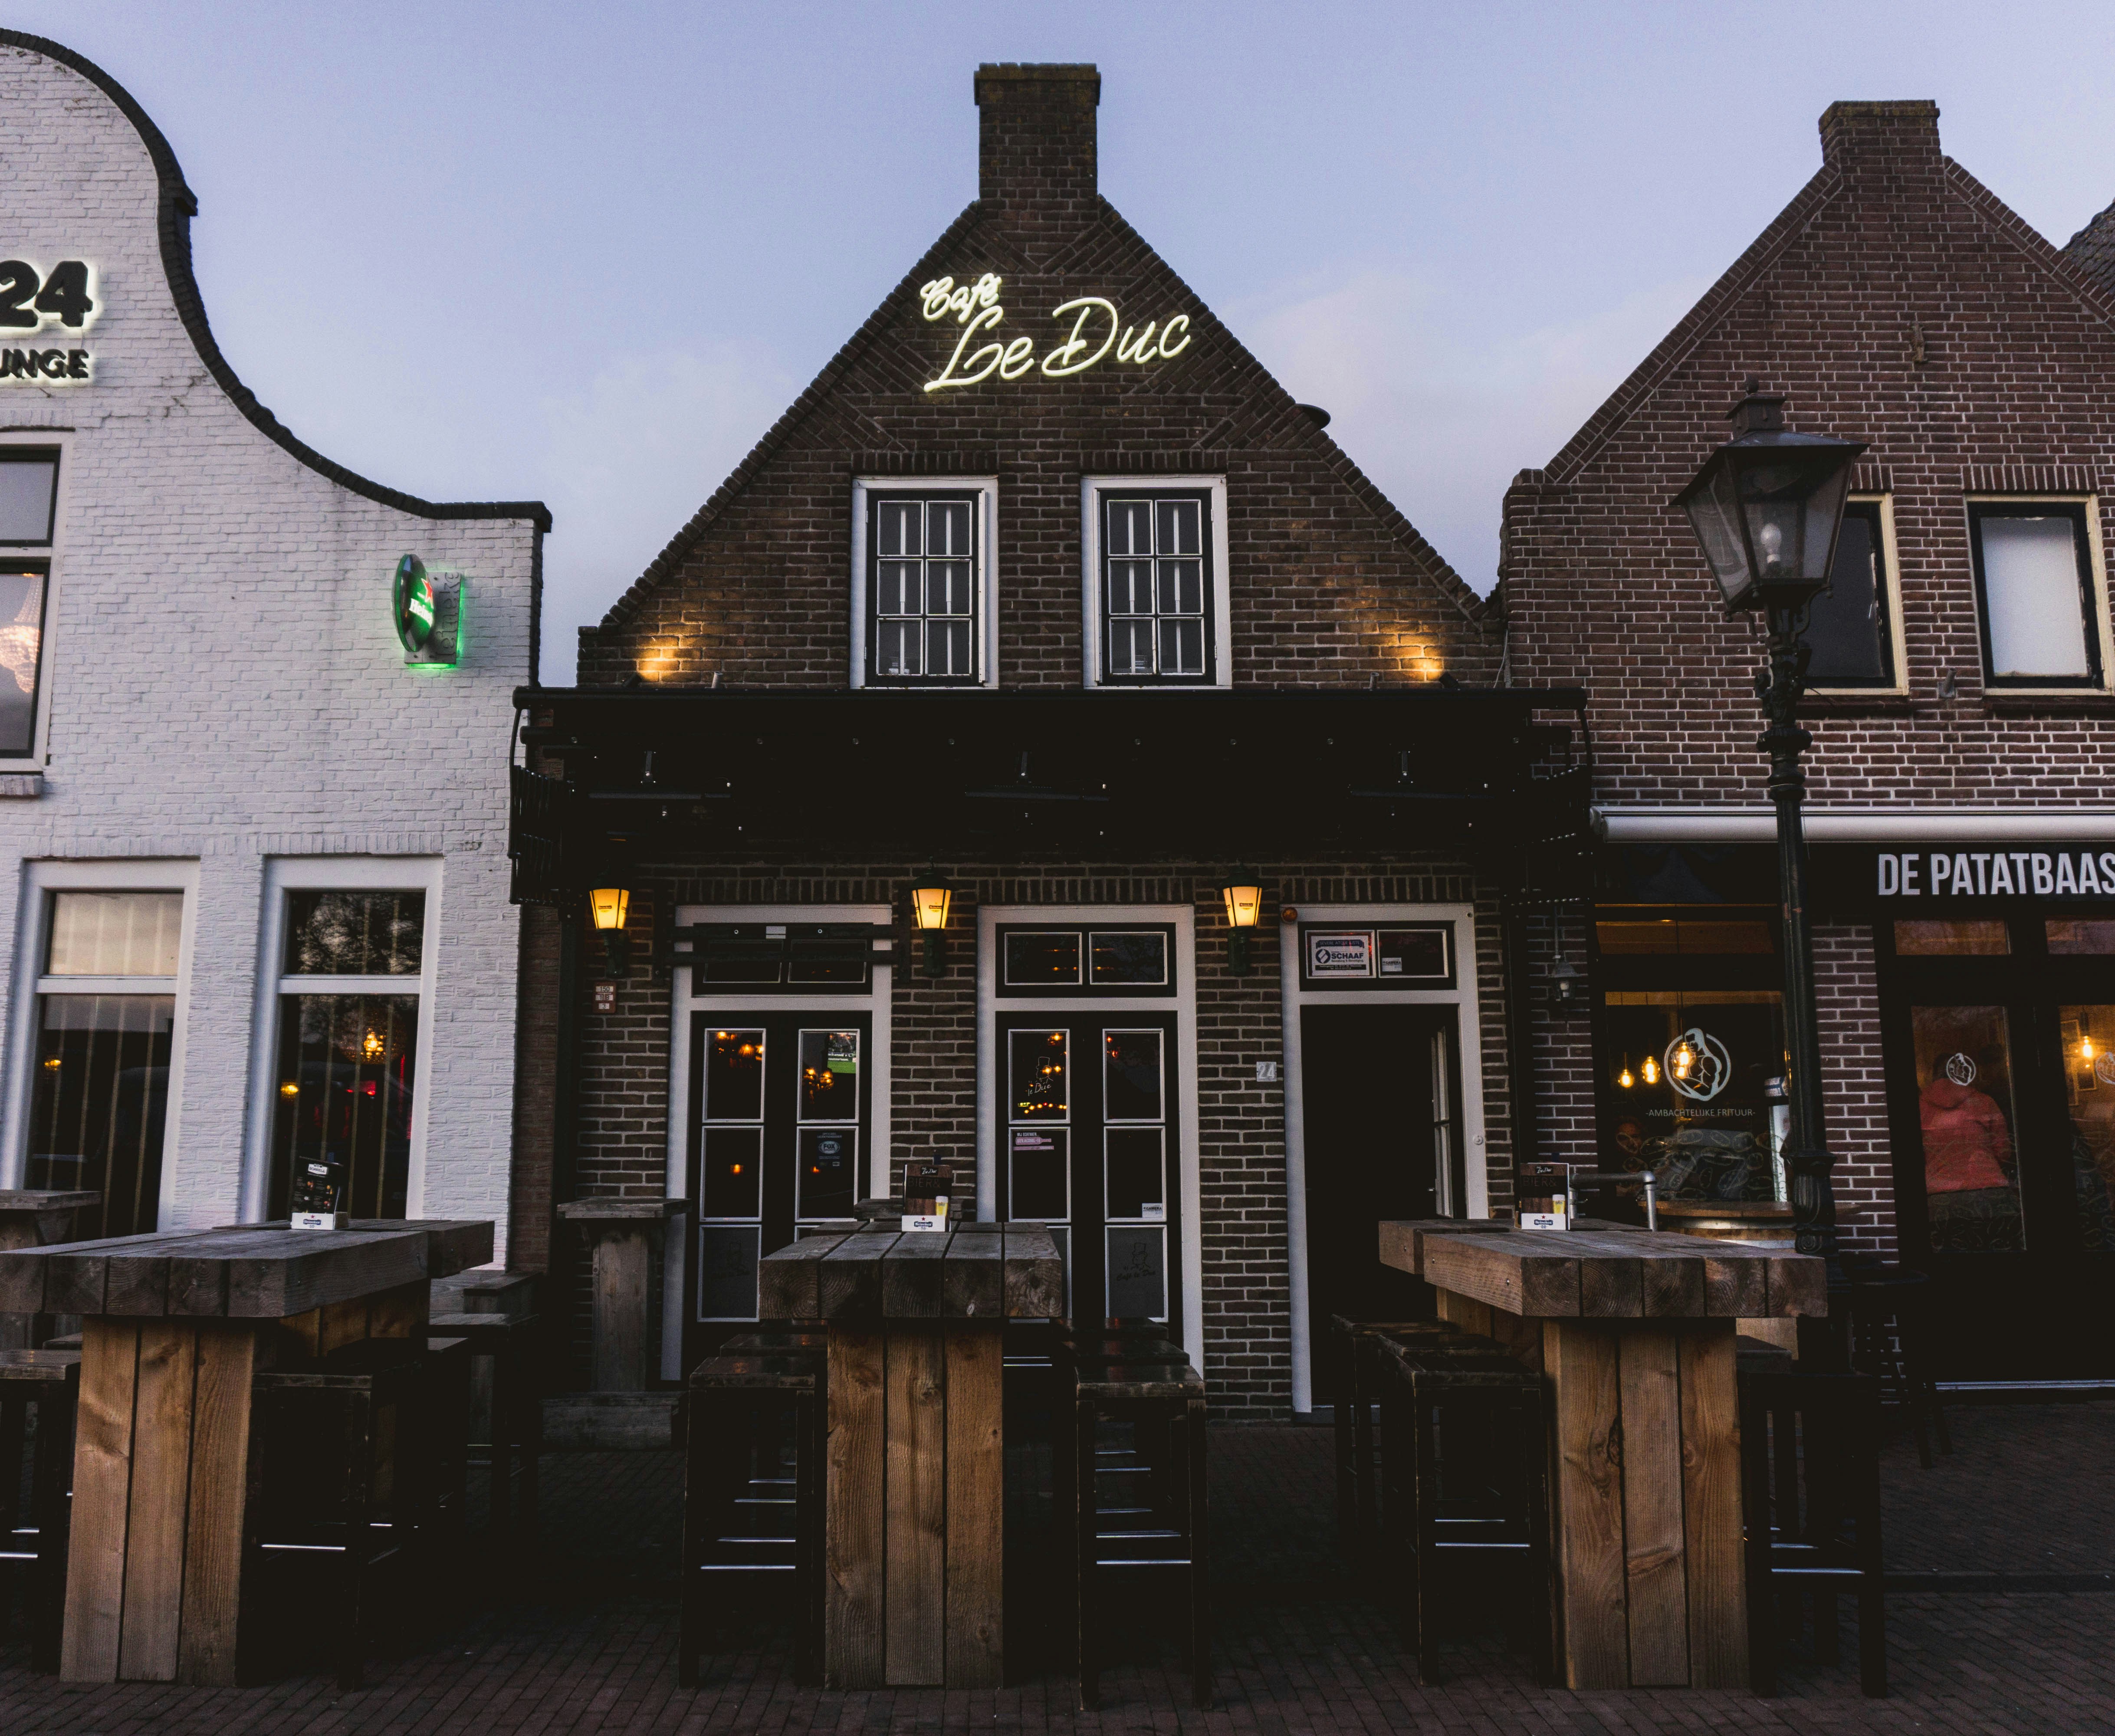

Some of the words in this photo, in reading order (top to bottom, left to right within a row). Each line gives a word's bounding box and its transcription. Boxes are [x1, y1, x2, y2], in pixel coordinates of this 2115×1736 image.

[0, 260, 93, 327] 24
[924, 306, 1035, 392] Le
[1042, 297, 1191, 377] Duc
[1878, 854, 1920, 895] DE
[1931, 852, 2115, 895] PATATBAAS
[1258, 1064, 1275, 1080] 24
